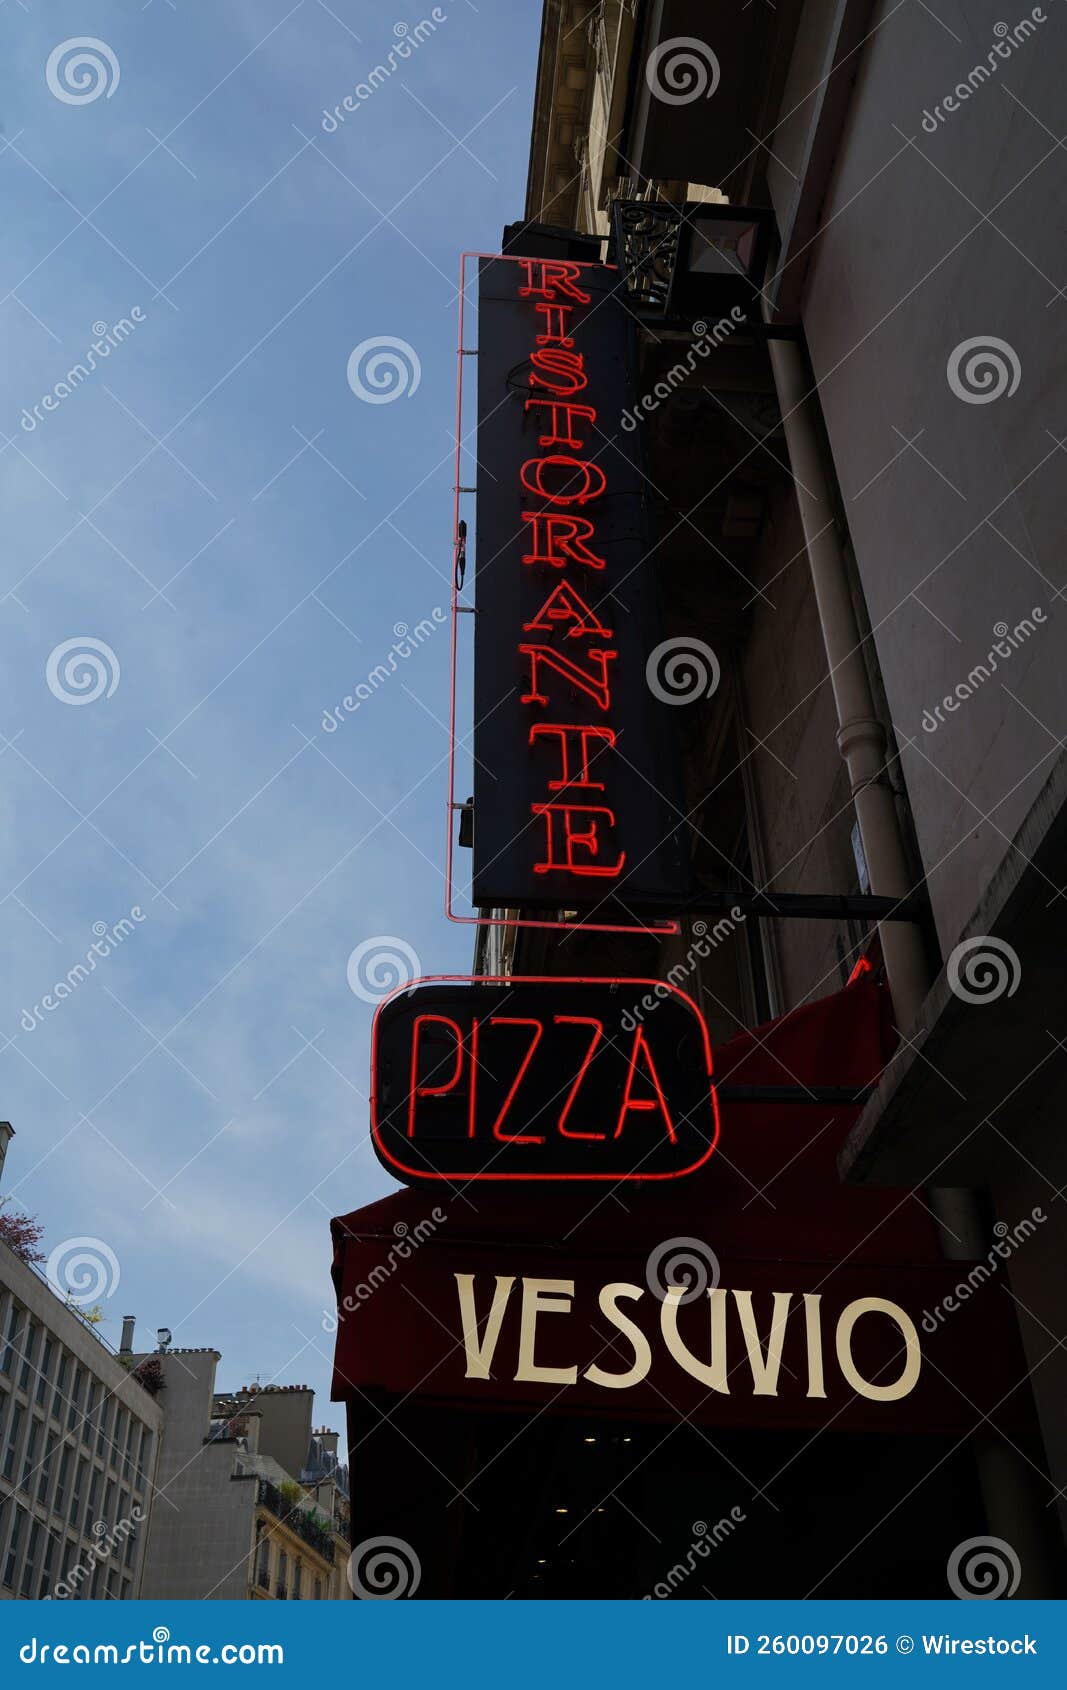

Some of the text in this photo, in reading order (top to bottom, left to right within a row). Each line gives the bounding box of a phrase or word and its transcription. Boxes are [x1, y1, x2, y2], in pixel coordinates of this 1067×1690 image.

[517, 260, 626, 878] RISTORANTE
[408, 1014, 677, 1144] PIZZA
[454, 1273, 922, 1402] VESUVIO
